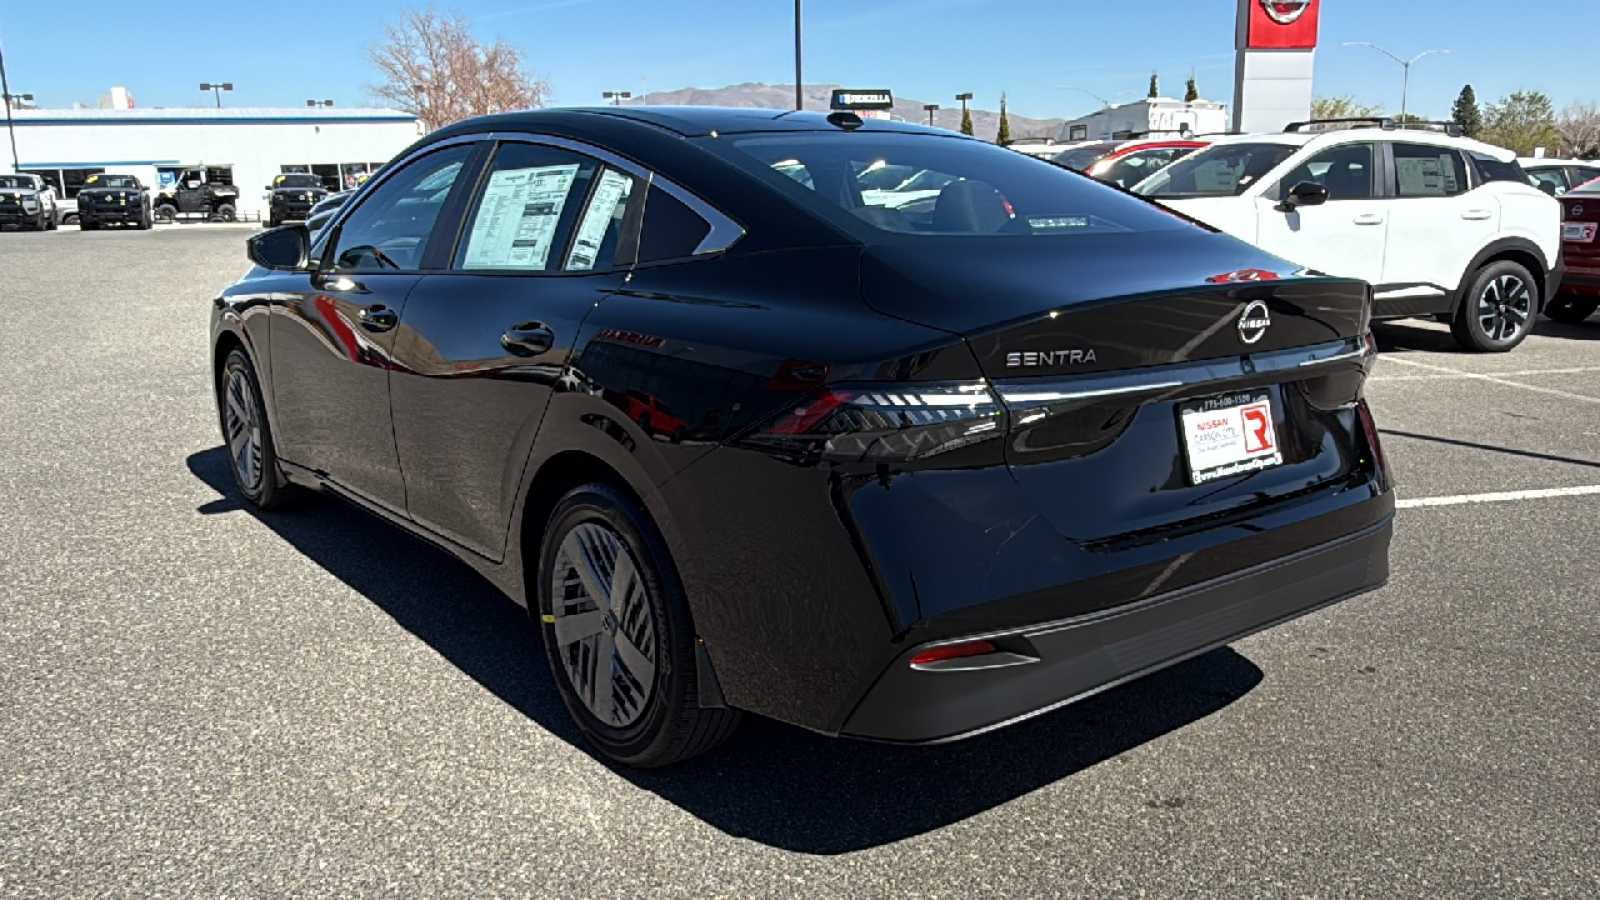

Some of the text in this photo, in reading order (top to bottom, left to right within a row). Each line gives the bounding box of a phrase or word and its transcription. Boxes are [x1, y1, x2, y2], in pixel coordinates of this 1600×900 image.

[1238, 317, 1271, 330] NISSAN
[1006, 349, 1097, 368] SENTRA
[1197, 418, 1229, 431] NISSAN
